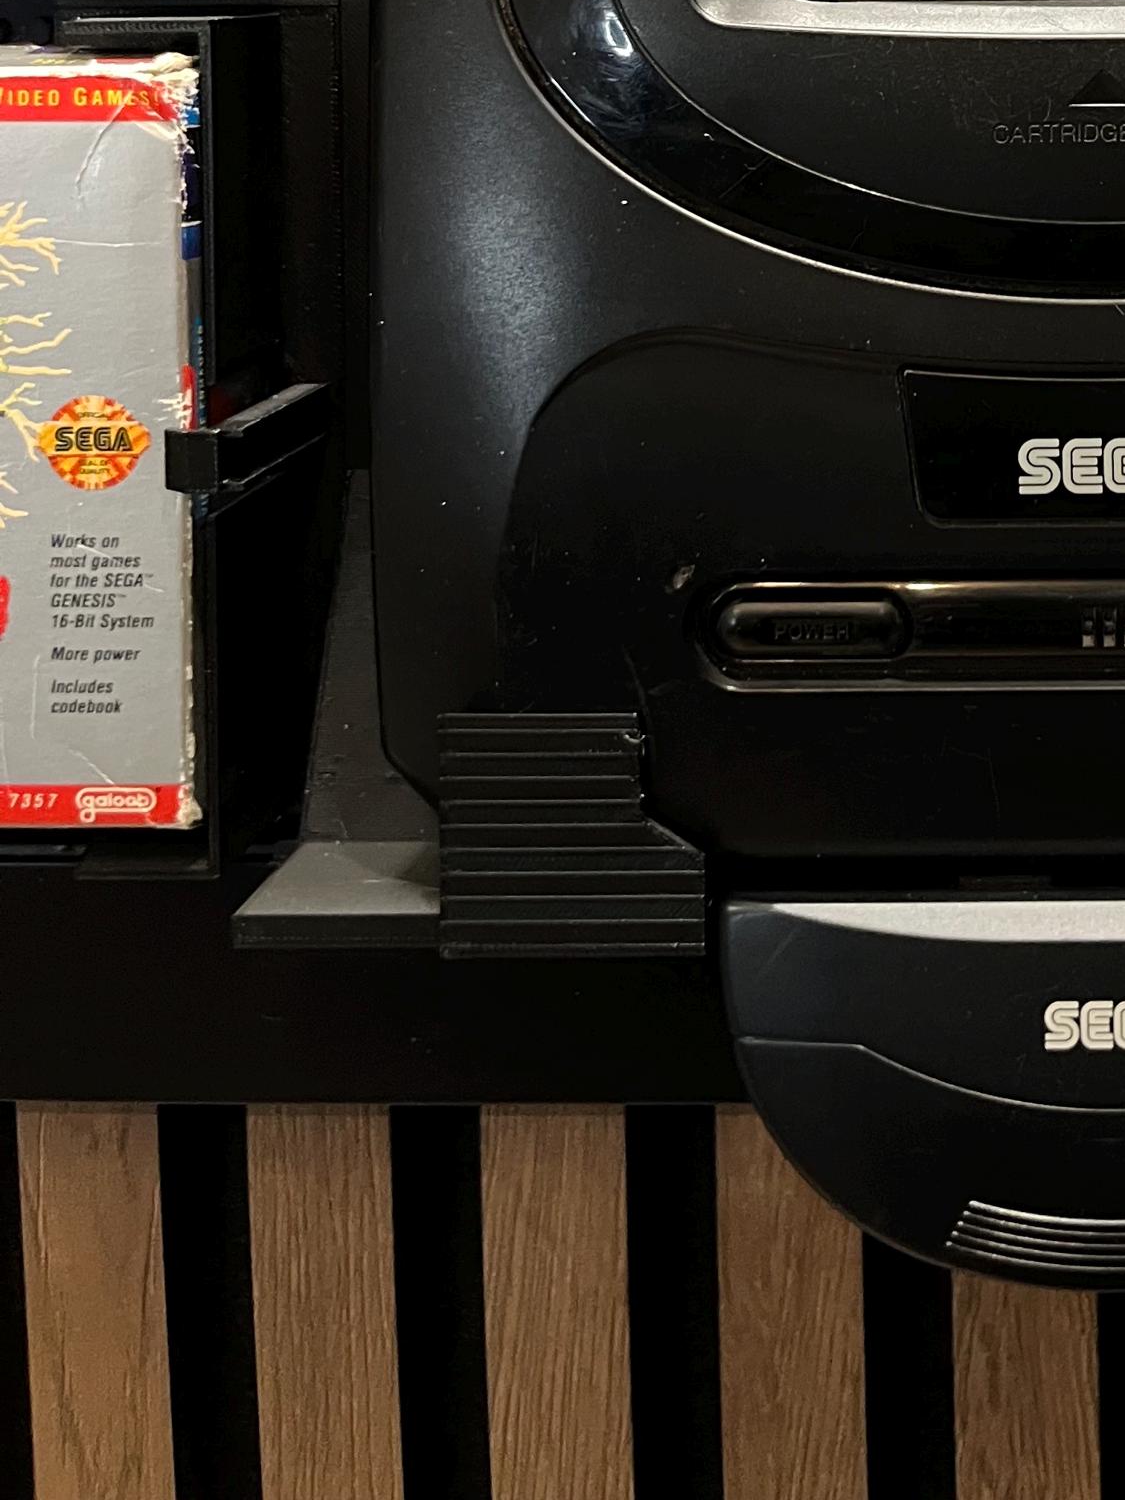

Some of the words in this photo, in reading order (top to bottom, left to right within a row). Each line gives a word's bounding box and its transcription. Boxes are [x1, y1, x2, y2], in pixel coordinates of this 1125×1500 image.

[54, 426, 134, 452] SEGA
[50, 533, 97, 548] Works
[101, 536, 120, 548] on
[49, 554, 87, 568] most
[91, 556, 142, 571] games
[50, 573, 71, 588] for
[75, 573, 98, 588] the
[51, 613, 96, 628] 16-Bit
[100, 613, 155, 631] System
[50, 646, 89, 661] More
[93, 649, 142, 664] power
[50, 679, 114, 694] Includes
[50, 699, 124, 714] codebook
[8, 792, 59, 809] 7357
[79, 789, 153, 823] galoob
